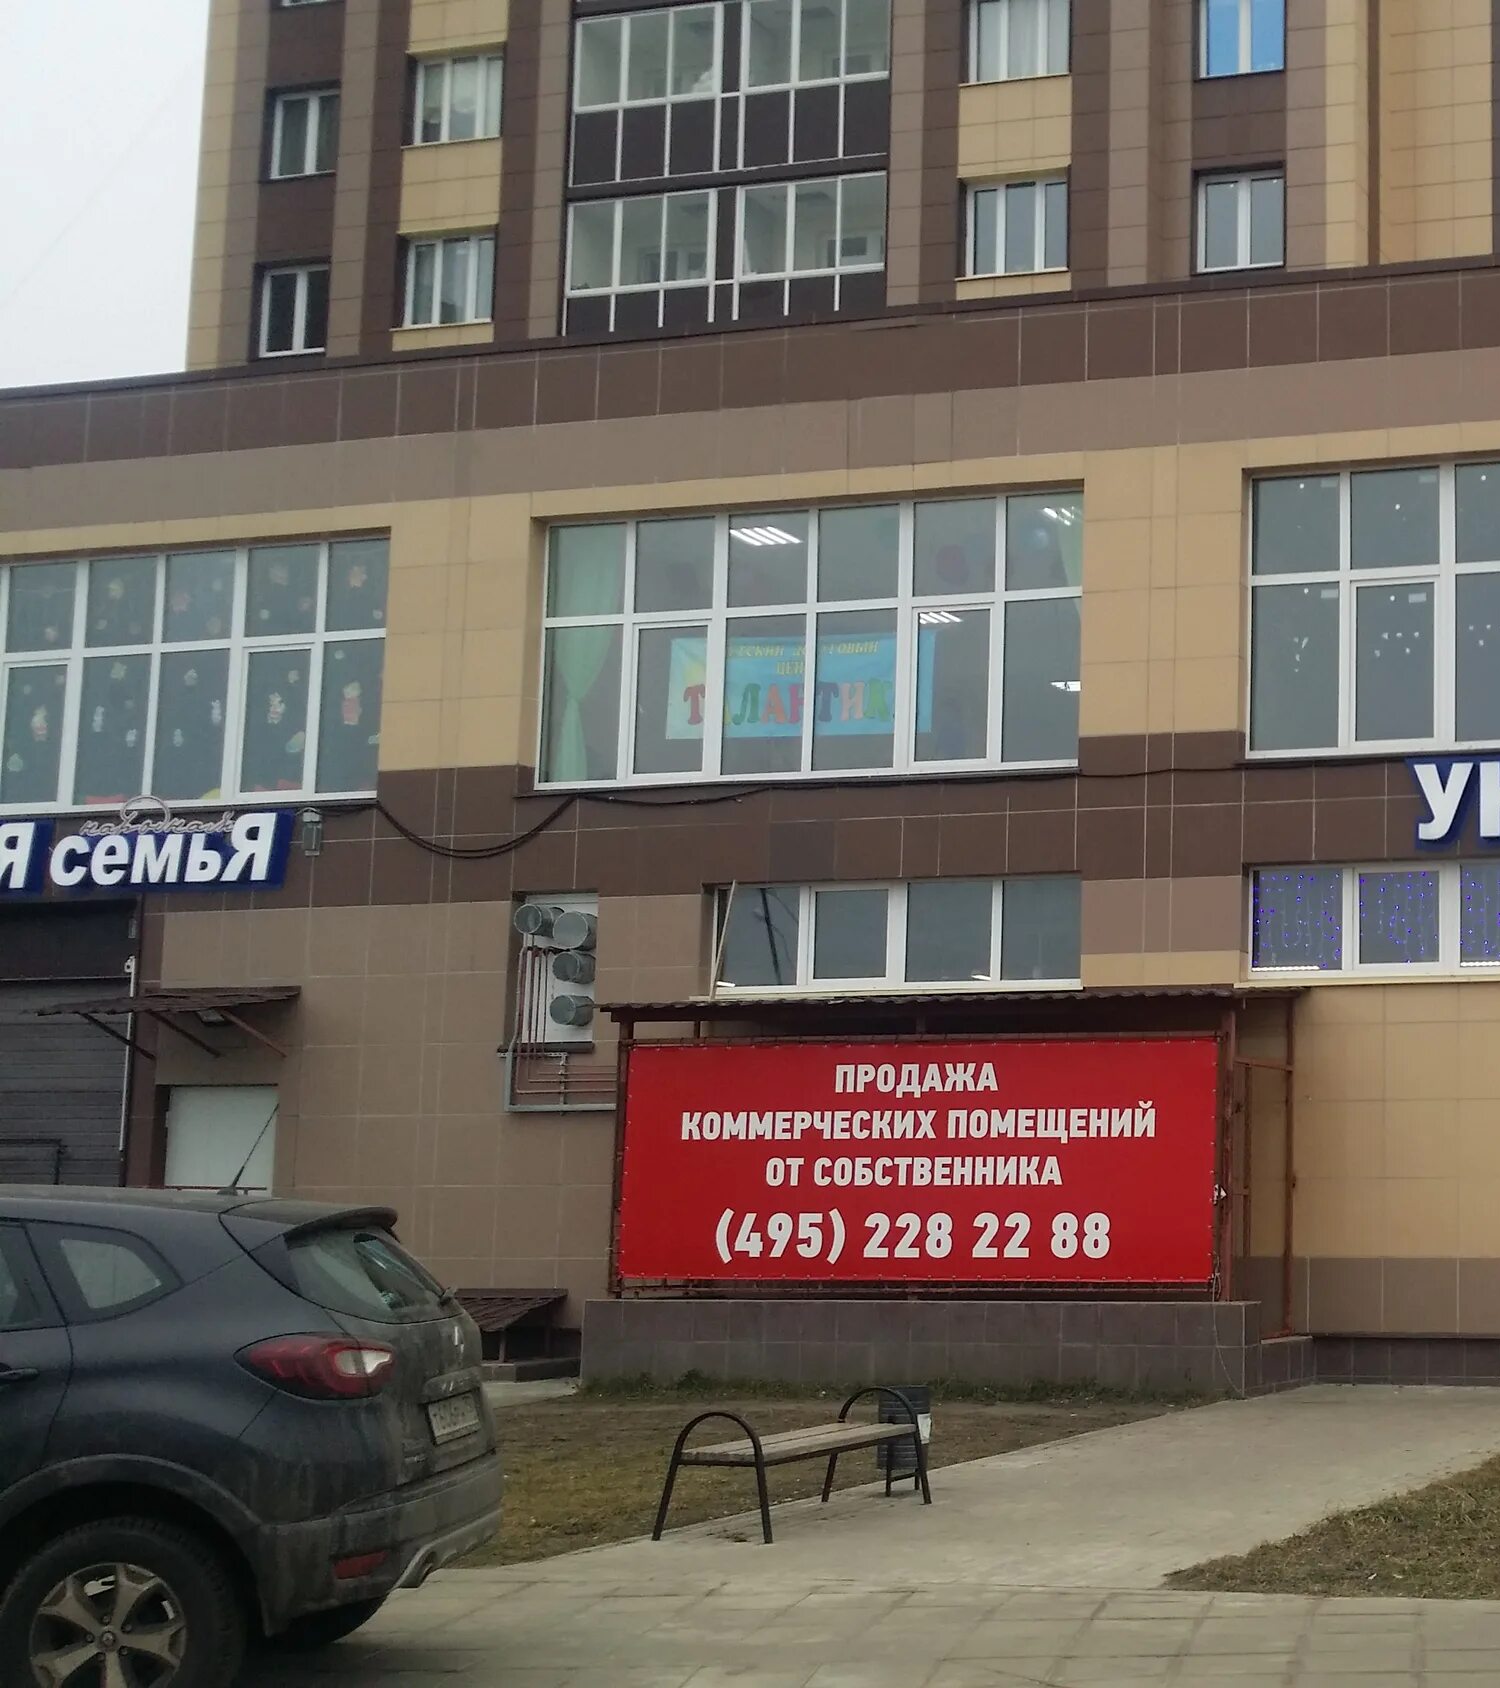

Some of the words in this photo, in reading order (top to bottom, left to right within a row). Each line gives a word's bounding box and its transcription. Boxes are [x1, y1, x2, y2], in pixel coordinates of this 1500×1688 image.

[682, 677, 894, 726] ТЛАНТИК
[834, 1062, 998, 1098] ПРОДАЖА
[681, 1108, 937, 1141] КОММЕРЧЕСКИХ
[946, 1101, 1157, 1144] ПОМЕЩЕНИЙ
[765, 1157, 805, 1187] ОТ
[812, 1155, 1063, 1187] СОБСТВЕННИКА
[714, 1207, 847, 1265] (495)
[862, 1212, 954, 1259] 228
[971, 1212, 1032, 1259] 22
[1049, 1212, 1111, 1259] 88
